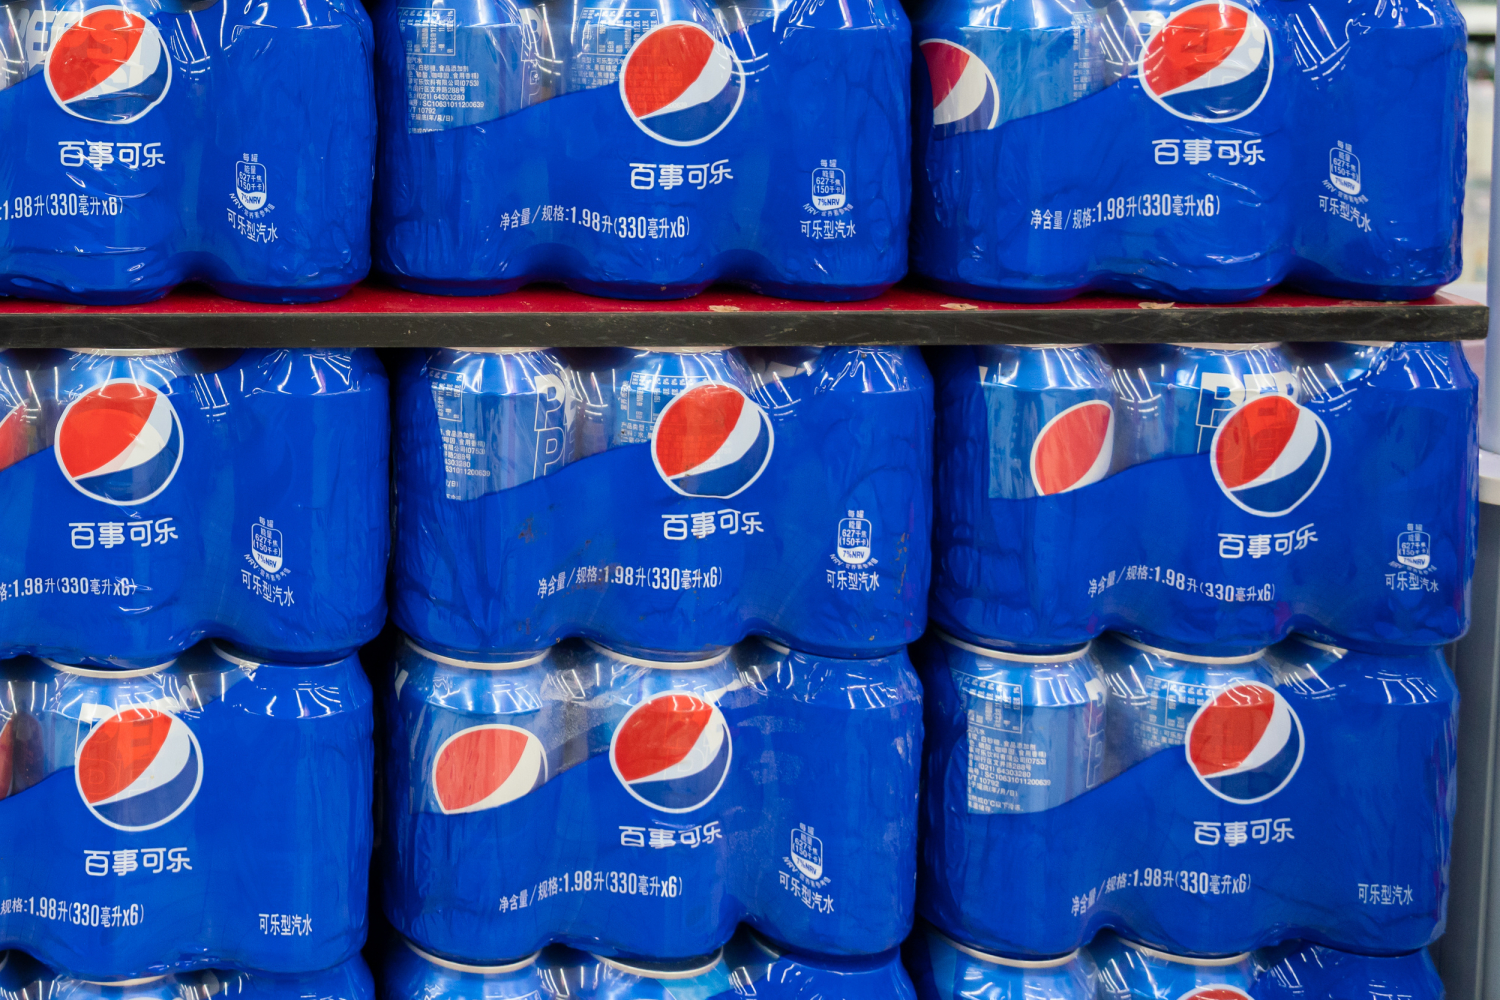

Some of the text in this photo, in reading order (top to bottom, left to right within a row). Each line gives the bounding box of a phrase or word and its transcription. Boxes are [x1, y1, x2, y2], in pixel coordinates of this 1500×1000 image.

[58, 140, 166, 168] 百事可乐
[1152, 138, 1265, 166] 百事可乐
[629, 160, 733, 190] 百事可乐
[227, 208, 278, 243] 可乐型汽水
[1318, 194, 1372, 232] 可乐型汽水
[800, 219, 856, 239] 可乐型汽水
[68, 517, 178, 549] 百事可乐
[661, 509, 763, 541] 百事可乐
[1217, 523, 1318, 559] 百事可乐
[240, 569, 295, 607] 可乐型汽水
[825, 570, 880, 592] 可乐型汽水
[1384, 572, 1439, 593] 可乐型汽水
[619, 822, 722, 850] 百事可乐
[1193, 818, 1295, 846] 百事可乐
[83, 846, 192, 876] 百事可乐
[779, 870, 834, 914] 可乐型汽水
[1358, 883, 1413, 905] 可乐型汽水
[258, 912, 312, 936] 可乐型汽水
